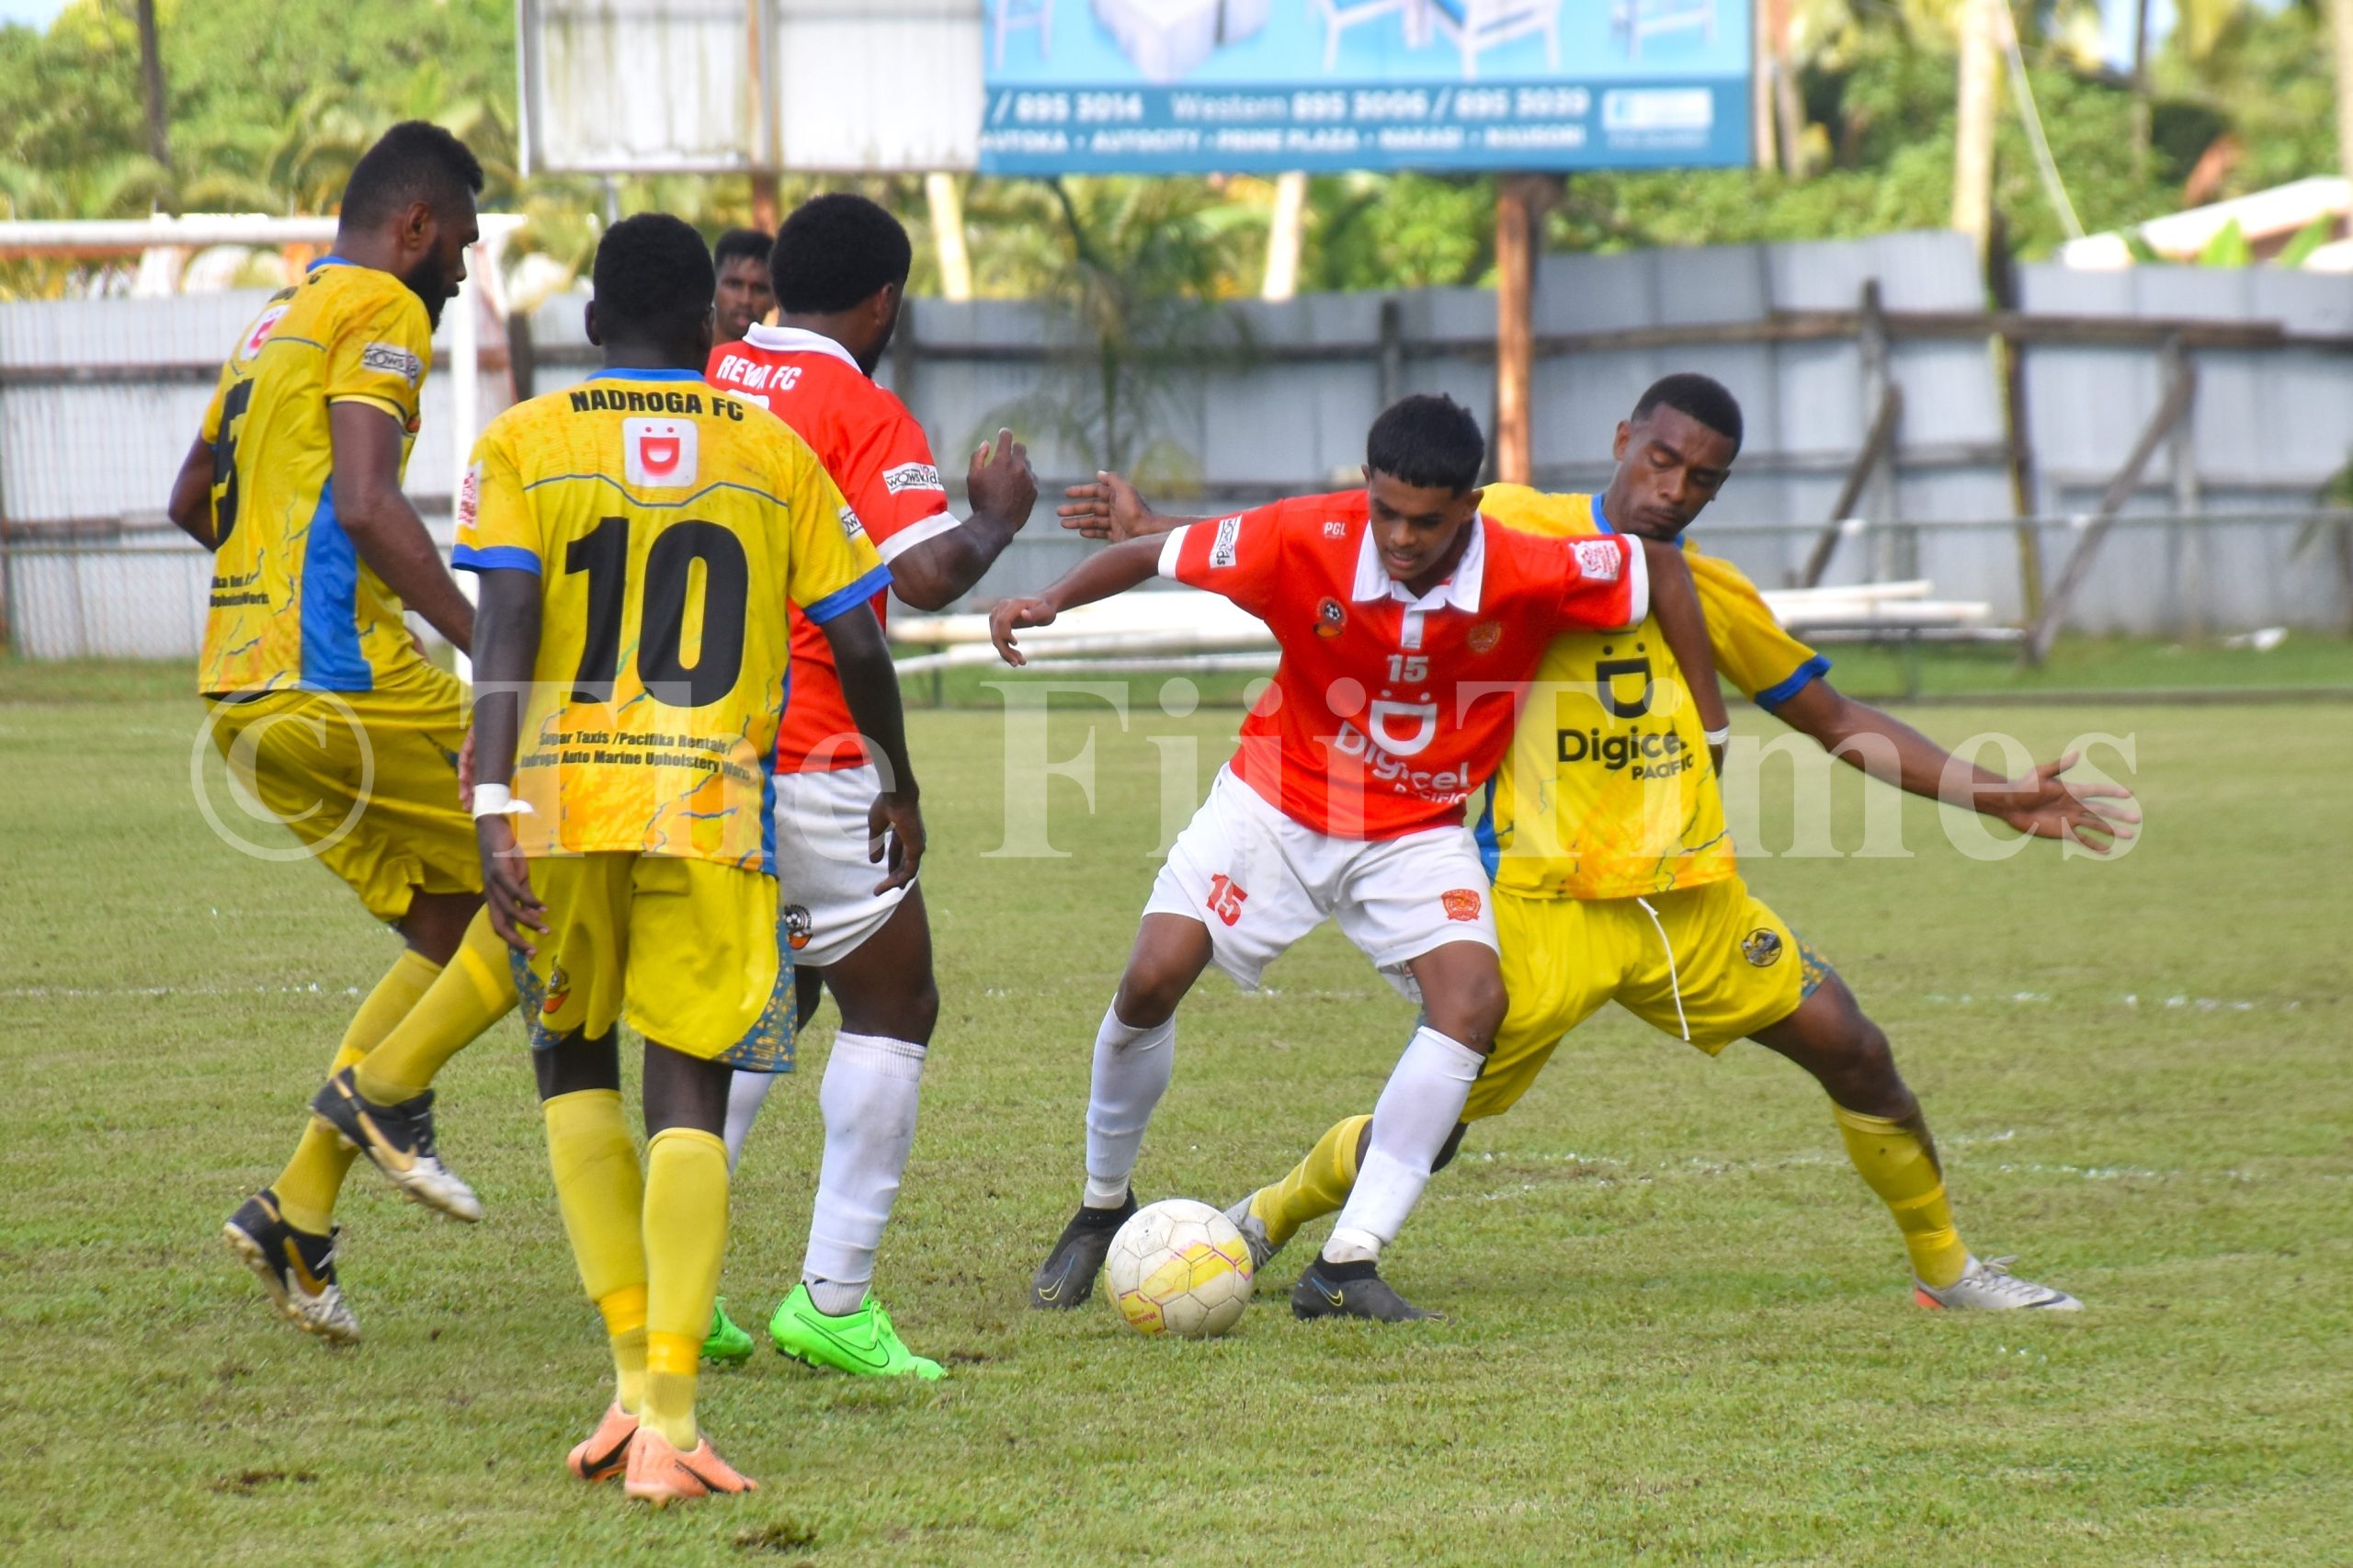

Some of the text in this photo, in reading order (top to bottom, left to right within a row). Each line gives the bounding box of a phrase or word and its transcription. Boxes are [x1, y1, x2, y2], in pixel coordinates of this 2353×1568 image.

[1169, 92, 1287, 121] Western
[716, 354, 802, 391] REWA FC
[569, 391, 702, 415] NADROGA
[711, 396, 744, 422] FC
[1324, 521, 1347, 536] PGL
[564, 517, 749, 708] 10
[1387, 653, 1429, 683] 15
[561, 750, 591, 764] Auto
[593, 749, 642, 765] Marine
[1334, 720, 1471, 790] Digicel
[1556, 725, 1688, 770] Digice
[1206, 873, 1248, 926] 15
